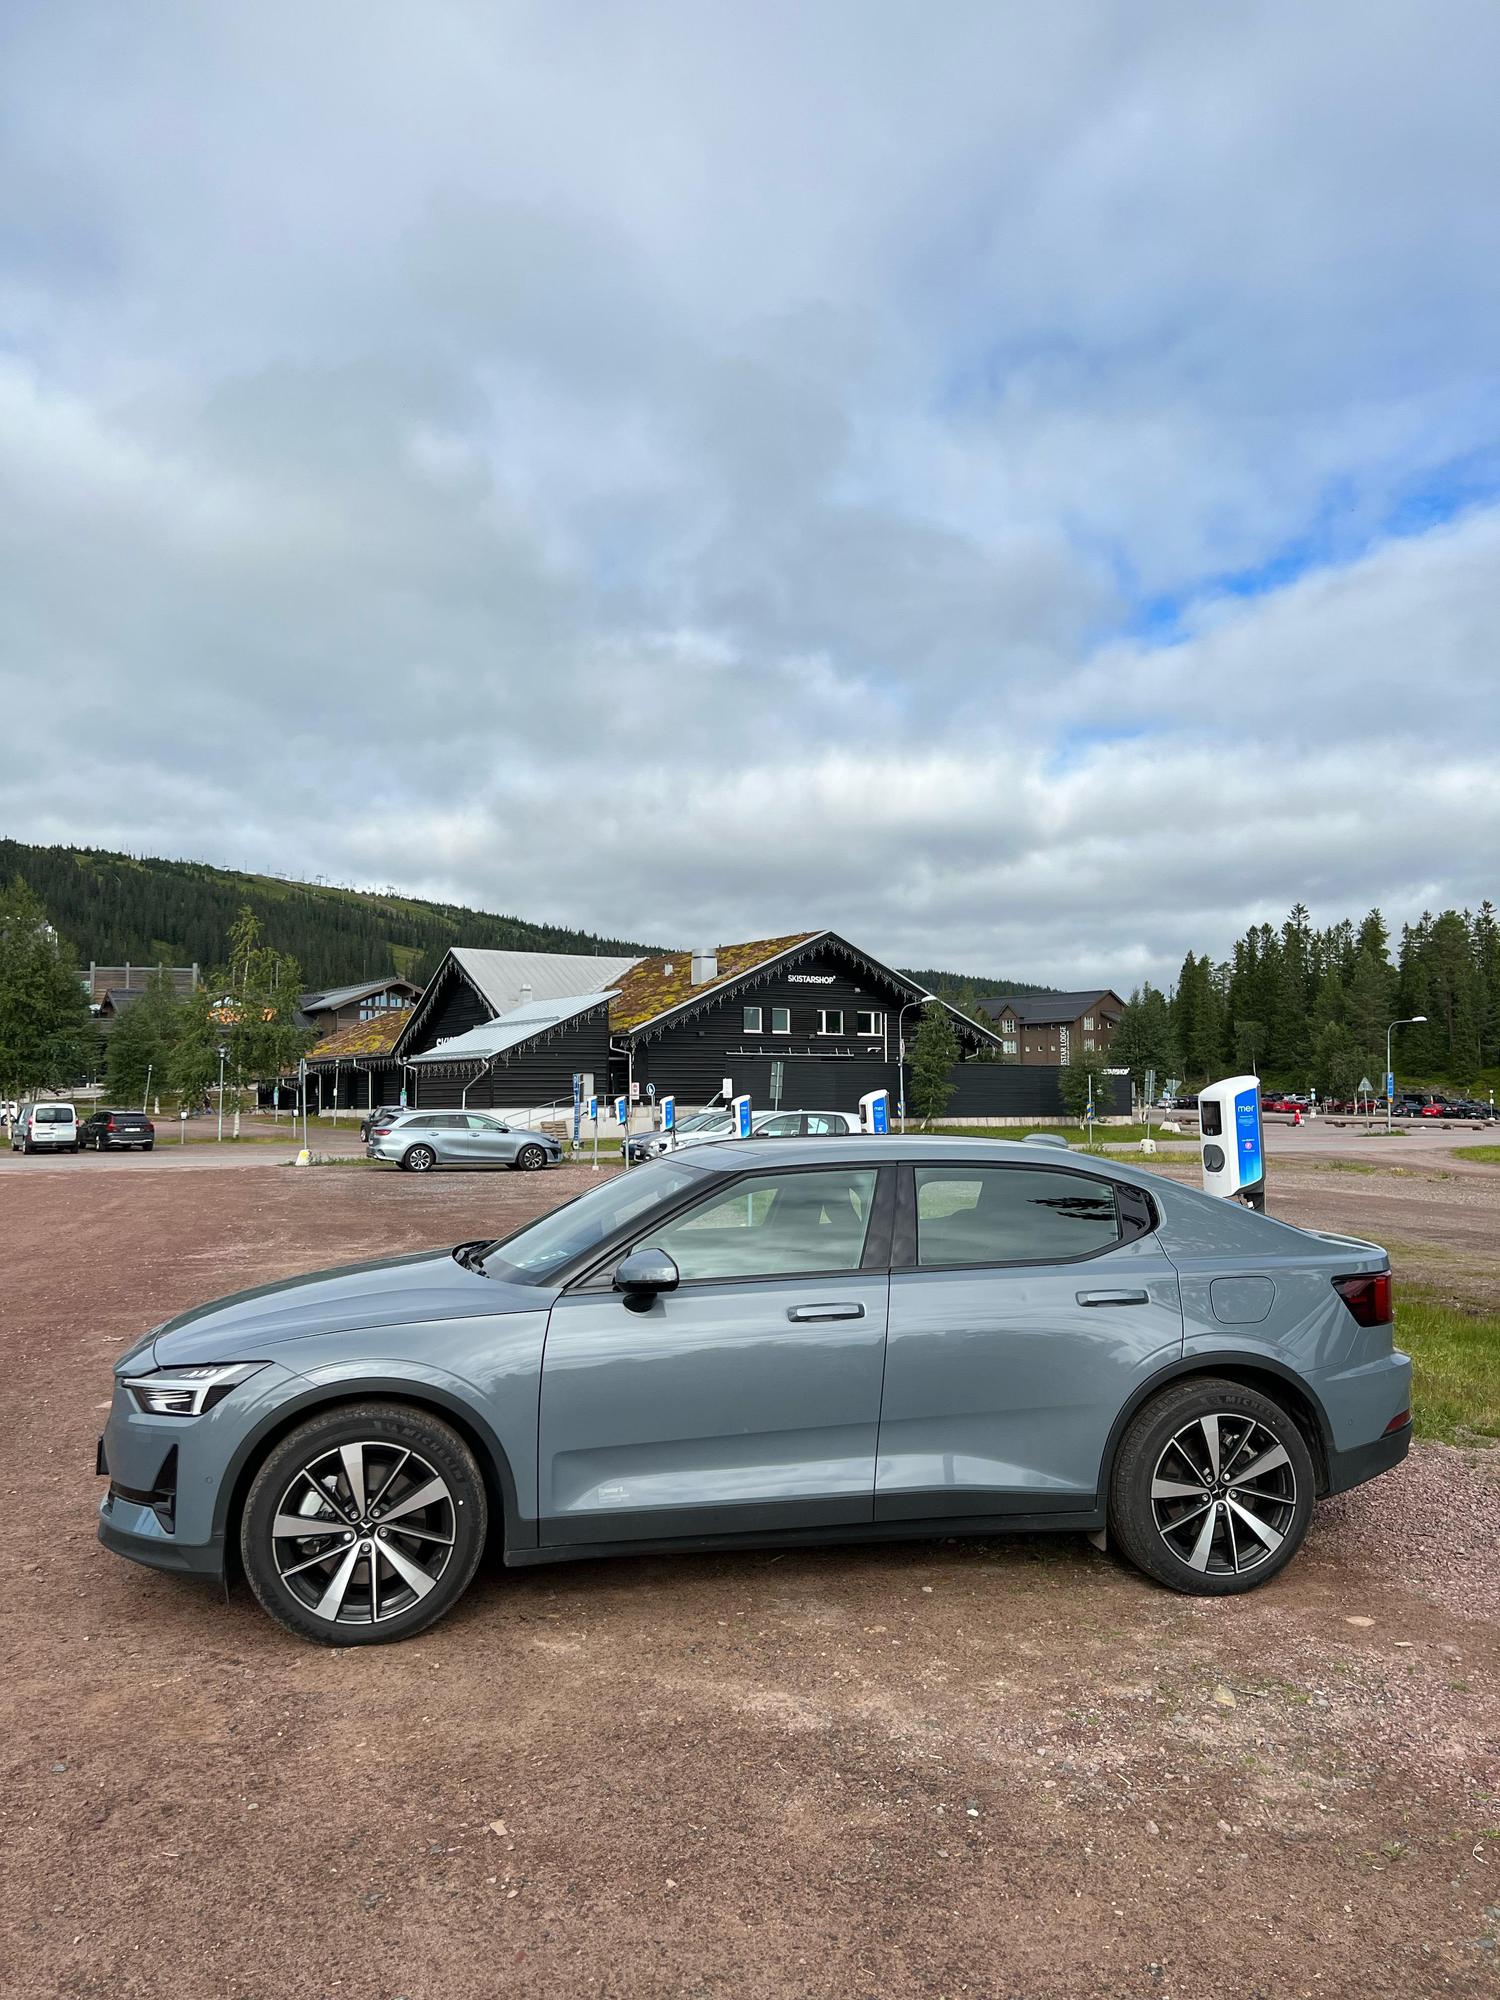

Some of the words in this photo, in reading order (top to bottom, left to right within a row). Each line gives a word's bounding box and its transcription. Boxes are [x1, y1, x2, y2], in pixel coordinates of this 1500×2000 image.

[788, 975, 834, 984] SKISTARSHOP
[1059, 1025, 1067, 1046] LODGE
[1237, 1105, 1255, 1113] mer
[401, 1426, 465, 1483] MICHELIN
